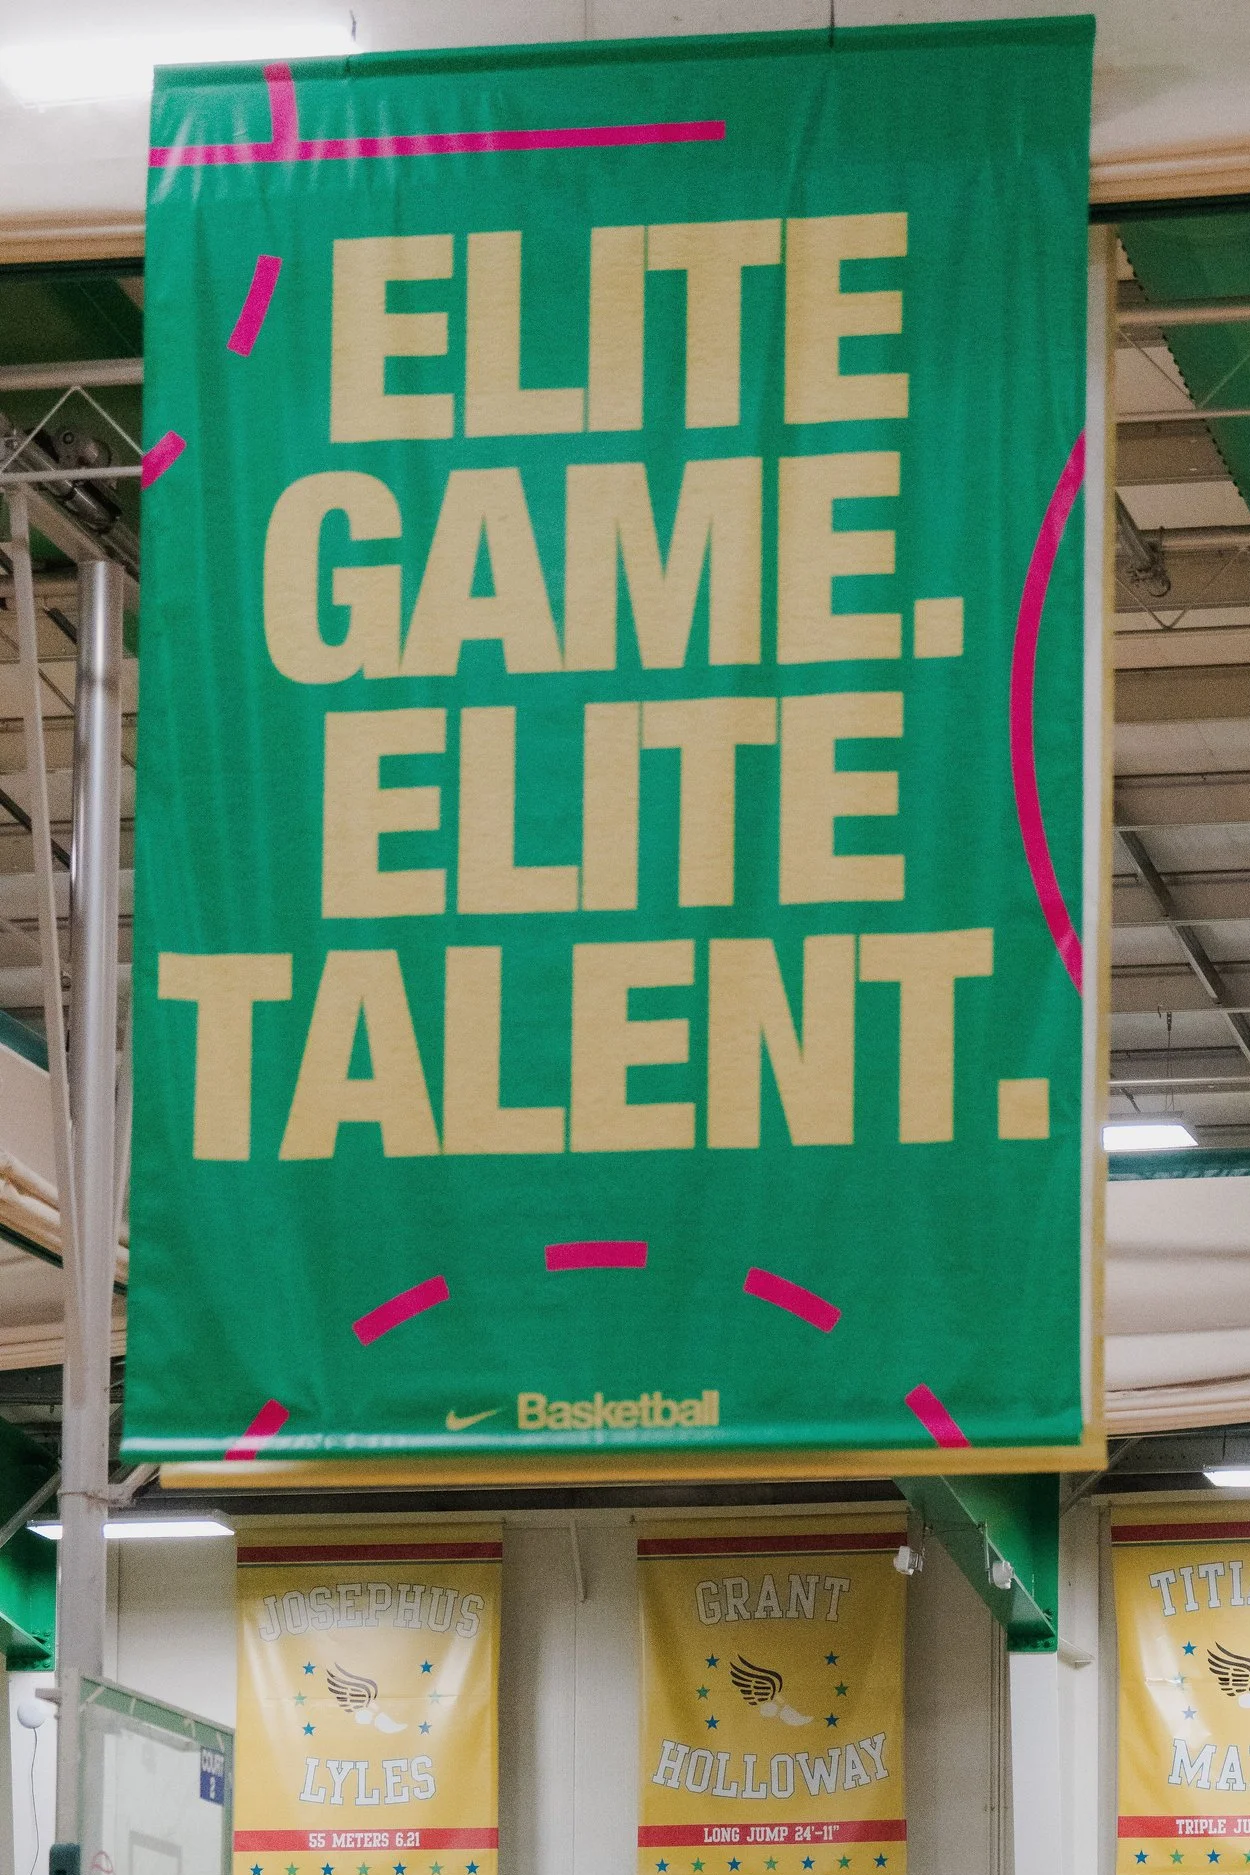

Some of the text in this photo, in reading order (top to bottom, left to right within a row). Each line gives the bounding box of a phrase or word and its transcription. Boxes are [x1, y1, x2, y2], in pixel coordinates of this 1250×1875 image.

[329, 212, 910, 444] ELITE
[261, 450, 966, 686] GAME.
[321, 690, 908, 920] ELITE
[156, 928, 1051, 1163] TALENT.
[517, 1389, 720, 1431] Basketball
[257, 1581, 485, 1643] JOSEPHUS
[694, 1572, 851, 1627] GRANT
[298, 1754, 437, 1807] LYLES
[651, 1731, 889, 1800] HOLLOWAY
[308, 1831, 421, 1848] 55 METERS 6.21
[703, 1827, 740, 1843] LONG
[746, 1826, 789, 1842] JUMP
[1176, 1818, 1227, 1834] TRIPLE
